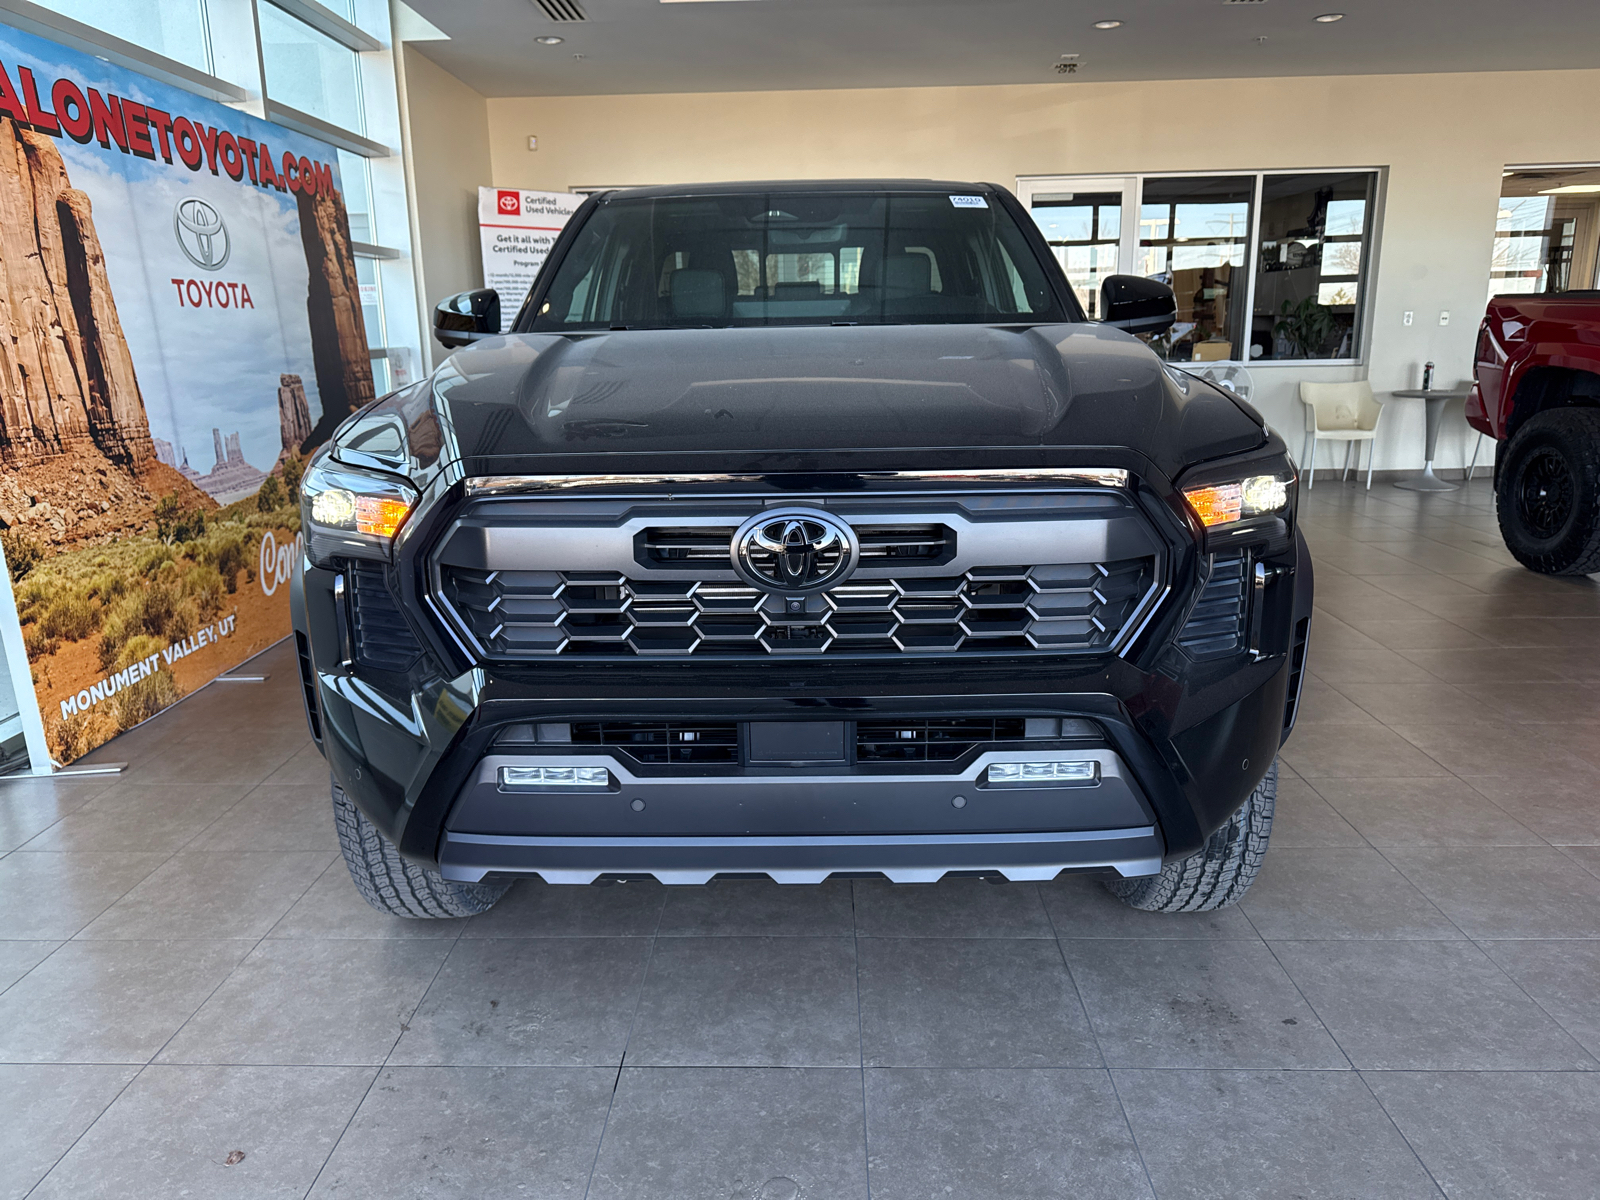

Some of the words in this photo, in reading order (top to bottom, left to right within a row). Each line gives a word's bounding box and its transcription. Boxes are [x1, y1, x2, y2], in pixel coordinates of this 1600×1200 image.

[525, 196, 557, 205] Certified
[513, 235, 519, 243] it
[521, 235, 531, 243] all
[532, 236, 550, 244] with
[493, 245, 528, 253] Certified
[529, 246, 549, 254] Used
[514, 260, 539, 268] Program
[171, 278, 254, 309] TOYOTA
[60, 652, 159, 721] MONUMENT
[162, 625, 218, 665] VALLEY,
[218, 614, 235, 636] UT
